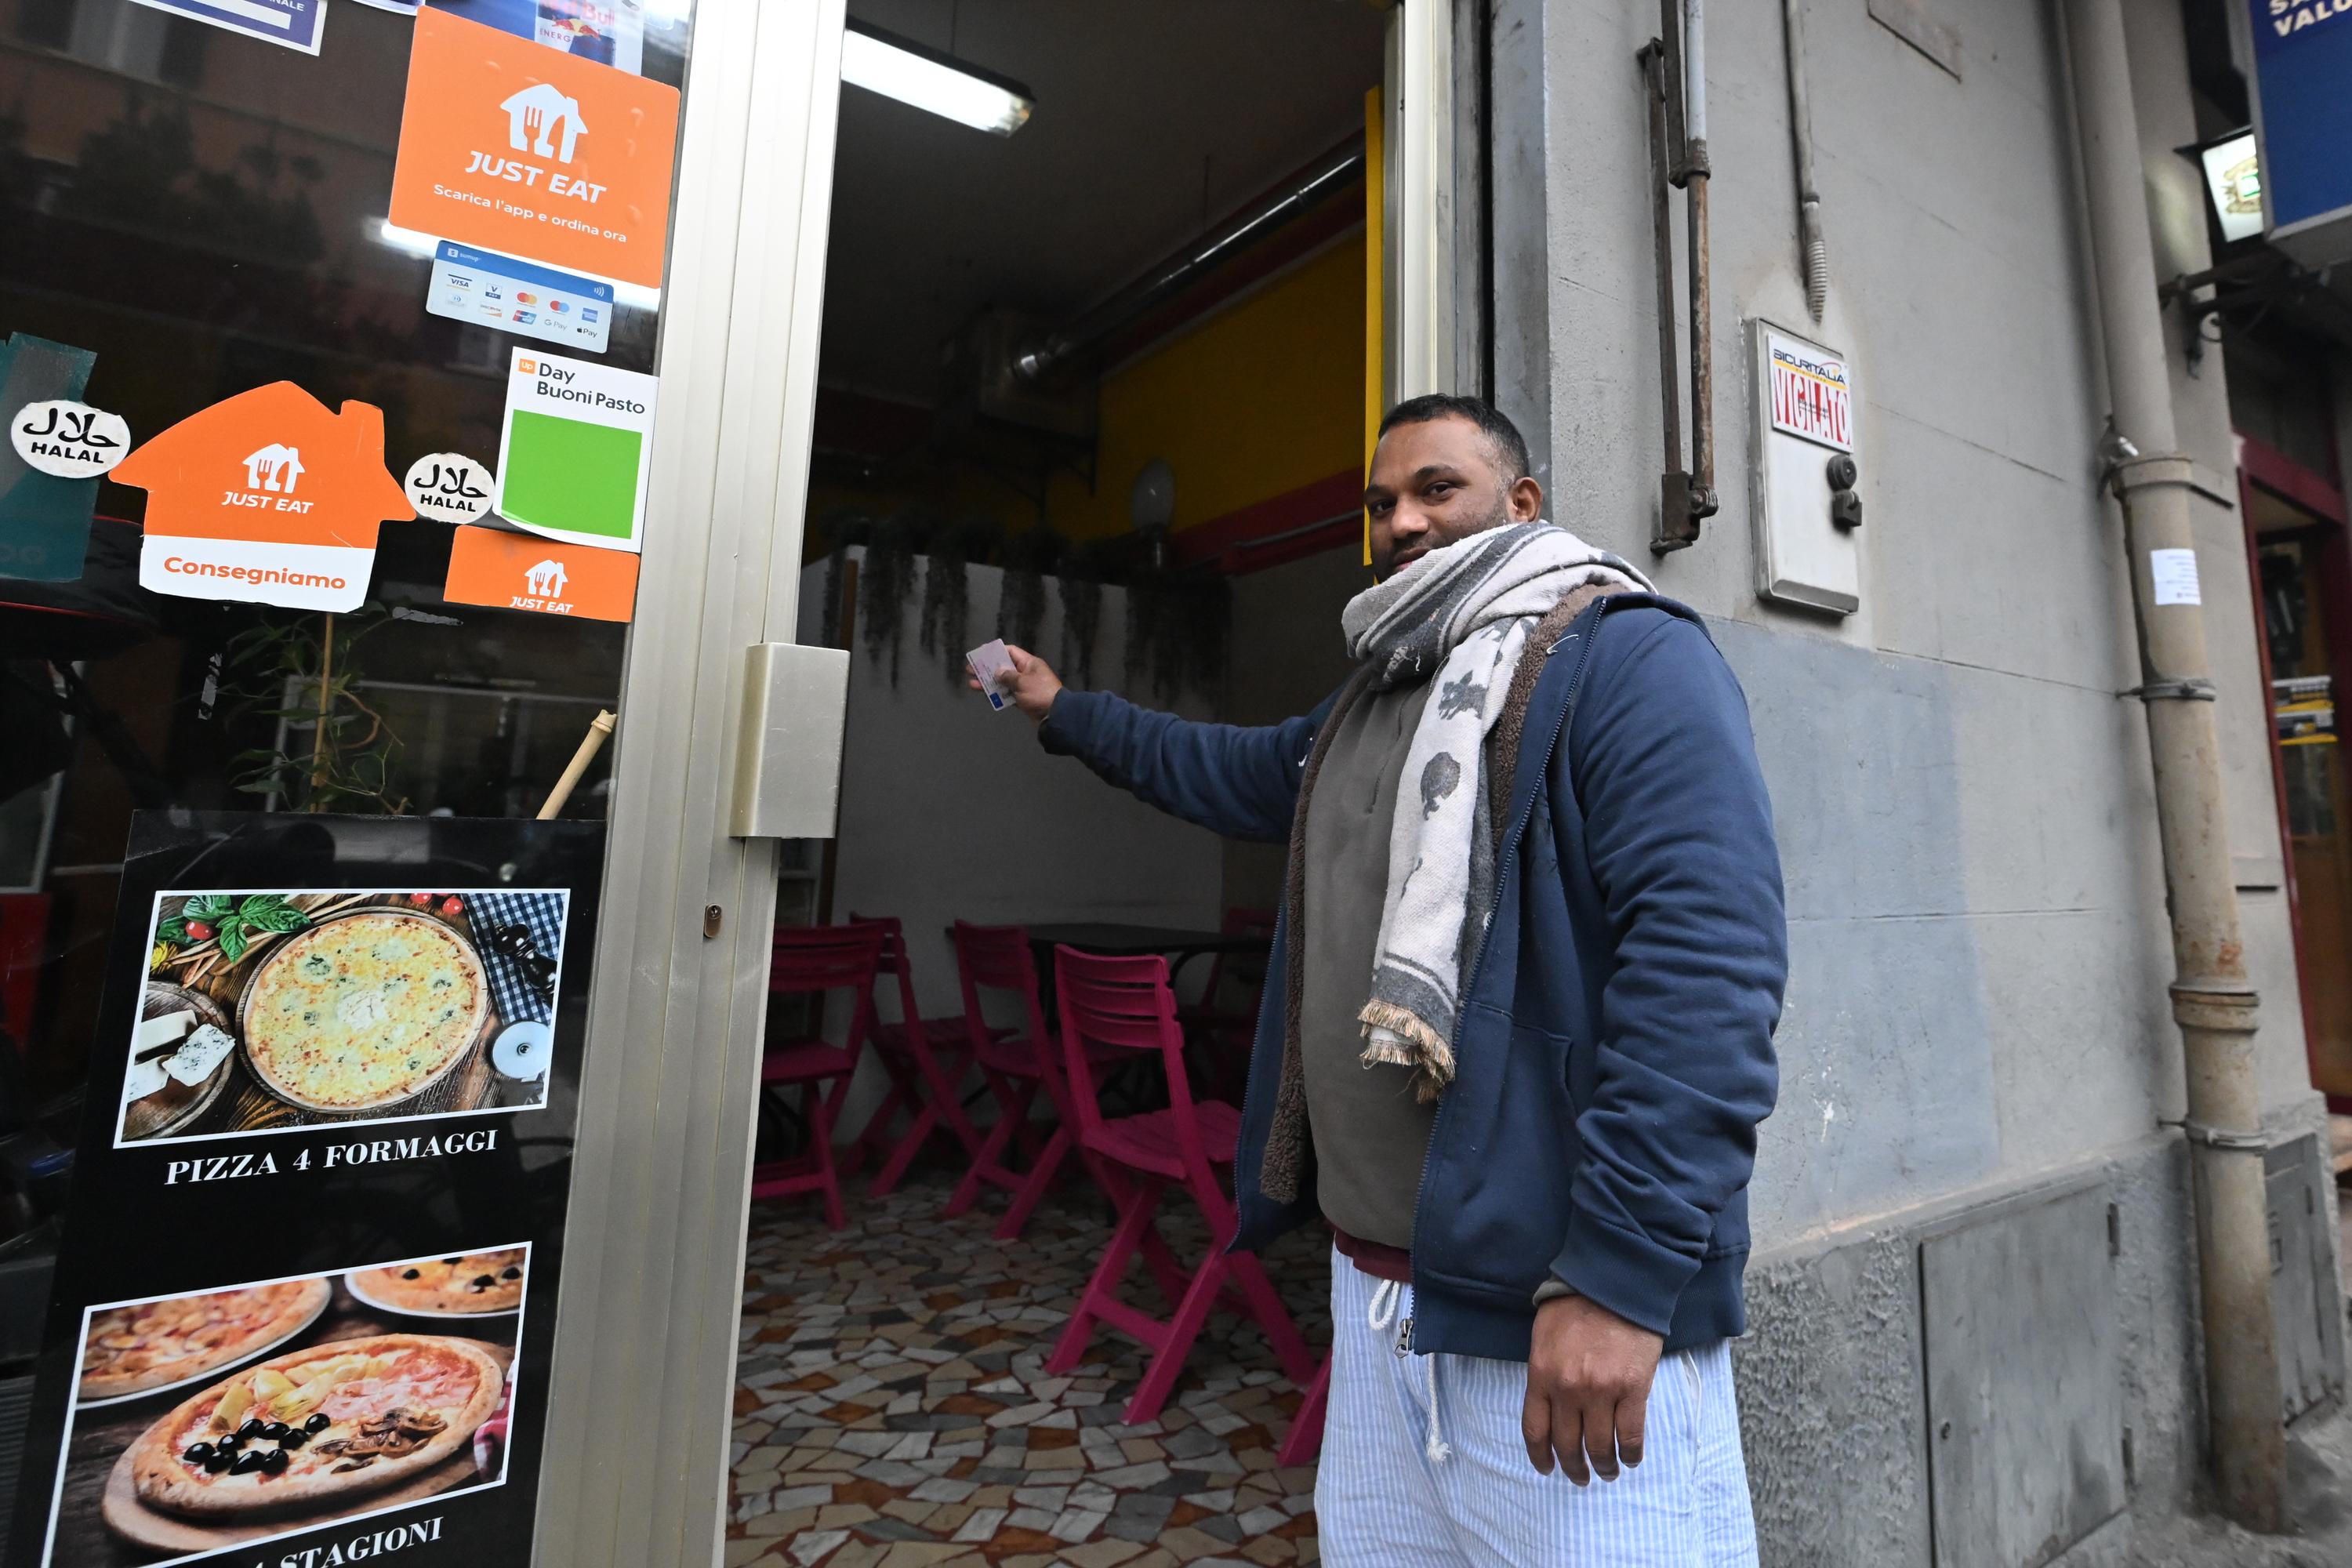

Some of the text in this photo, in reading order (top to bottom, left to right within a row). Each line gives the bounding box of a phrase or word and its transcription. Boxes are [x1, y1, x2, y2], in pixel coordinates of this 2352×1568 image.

[465, 150, 608, 204] JUST EAT
[434, 184, 627, 243] Scarica l'app e ordina ora
[451, 278, 469, 288] VISA
[554, 321, 568, 330] Pay
[583, 328, 597, 338] Pay
[521, 361, 575, 385] Up Day
[536, 380, 645, 415] Buoni Pasto
[1773, 365, 1850, 445] VIGILATO
[23, 408, 120, 448] حلال
[31, 441, 104, 464] HALAL
[413, 463, 488, 498] حلال
[221, 491, 314, 514] JUST EAT
[420, 494, 477, 513] HALAL
[164, 557, 346, 590] Consegniamo
[509, 596, 574, 614] JUST EAT
[164, 1130, 499, 1185] PIZZA 4 FORMAGGI
[280, 1516, 445, 1568] STAGIONI
